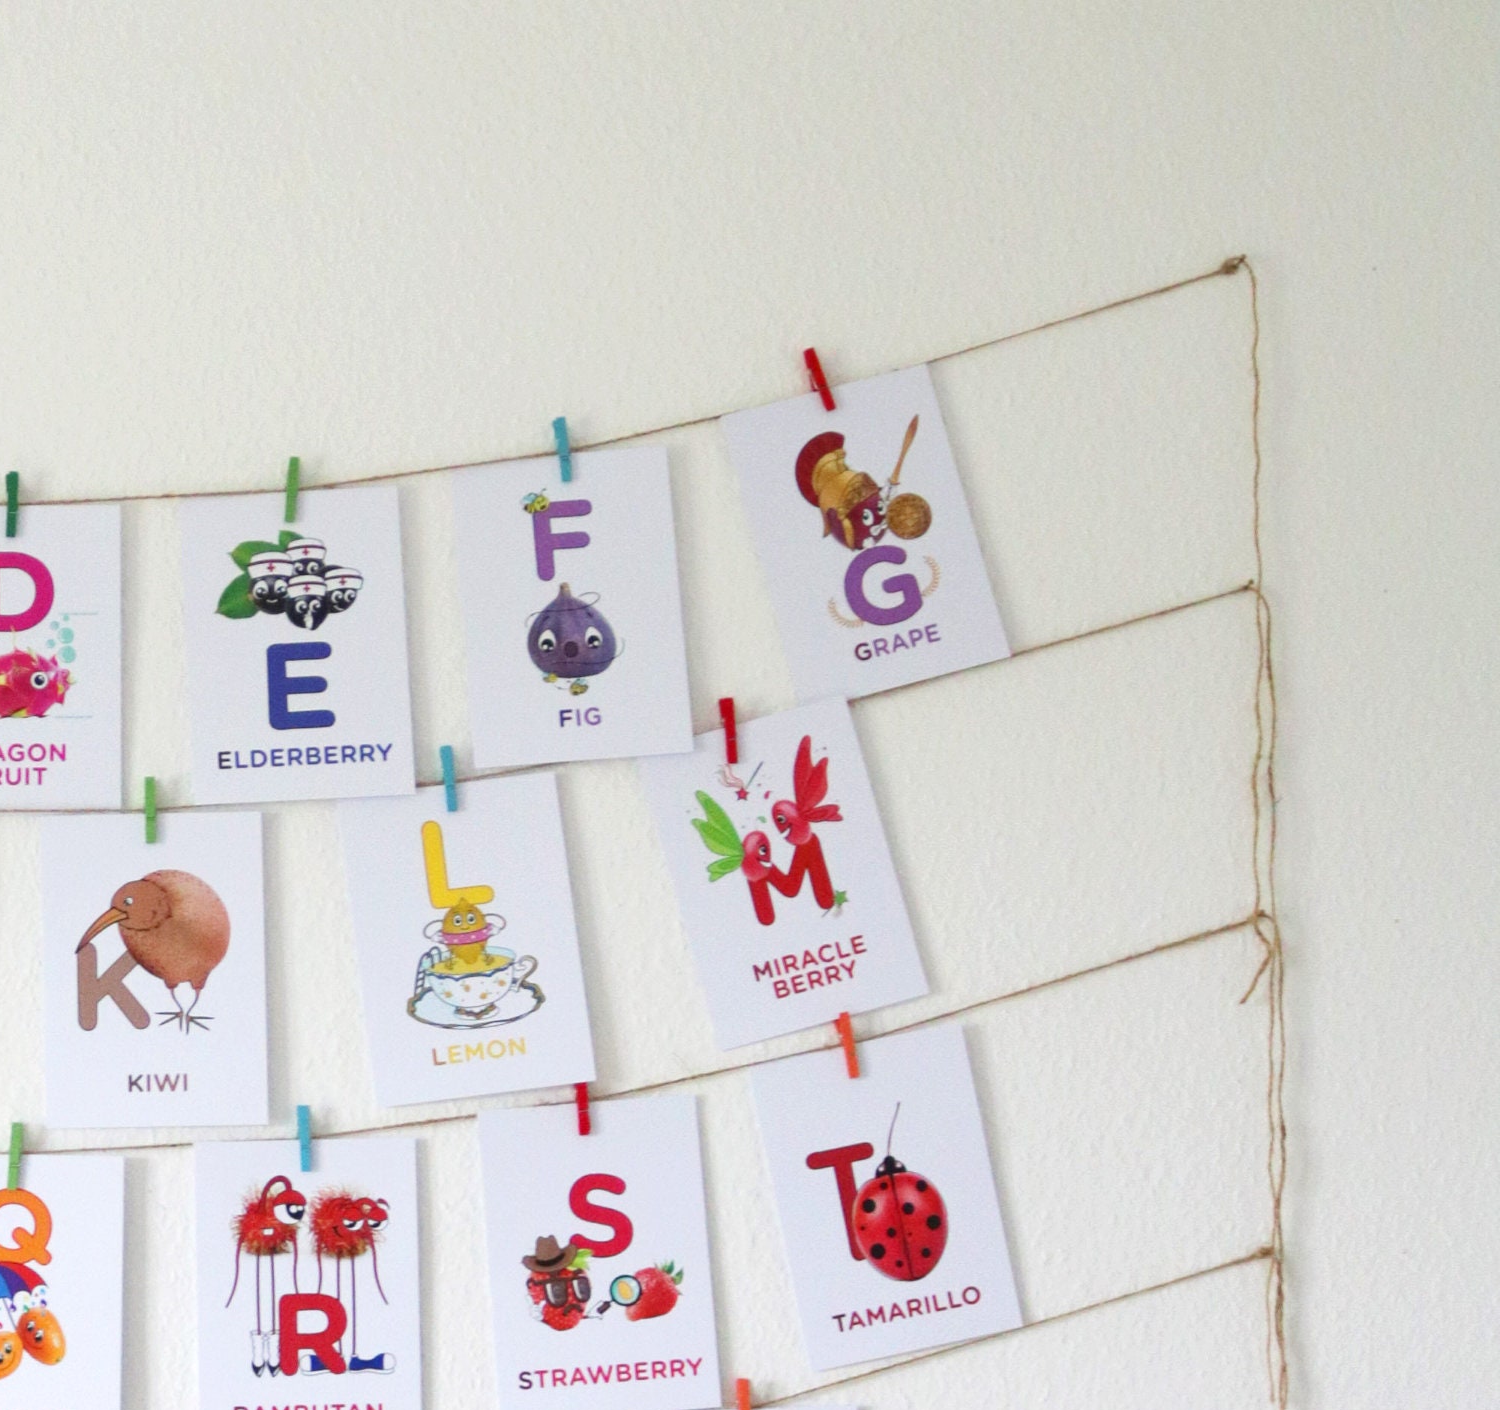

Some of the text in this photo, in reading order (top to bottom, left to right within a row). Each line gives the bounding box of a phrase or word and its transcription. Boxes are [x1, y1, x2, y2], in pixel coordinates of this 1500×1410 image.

[532, 499, 592, 581] F
[844, 544, 923, 625] G
[853, 623, 942, 662] GRAPE
[265, 641, 336, 731] E
[558, 707, 603, 727] FIG
[217, 743, 393, 770] ELDERBERRY
[421, 820, 495, 909] L
[746, 834, 835, 926] M
[76, 942, 151, 1031] K
[751, 934, 868, 983] MIRACLE
[771, 960, 858, 999] BERRY
[127, 1073, 189, 1094] KIWI
[431, 1037, 527, 1067] LEMON
[568, 1172, 634, 1259] S
[806, 1141, 875, 1262] T
[278, 1293, 348, 1377] R
[831, 1285, 982, 1334] TAMARILLO
[517, 1357, 703, 1391] STRAWBERRY
